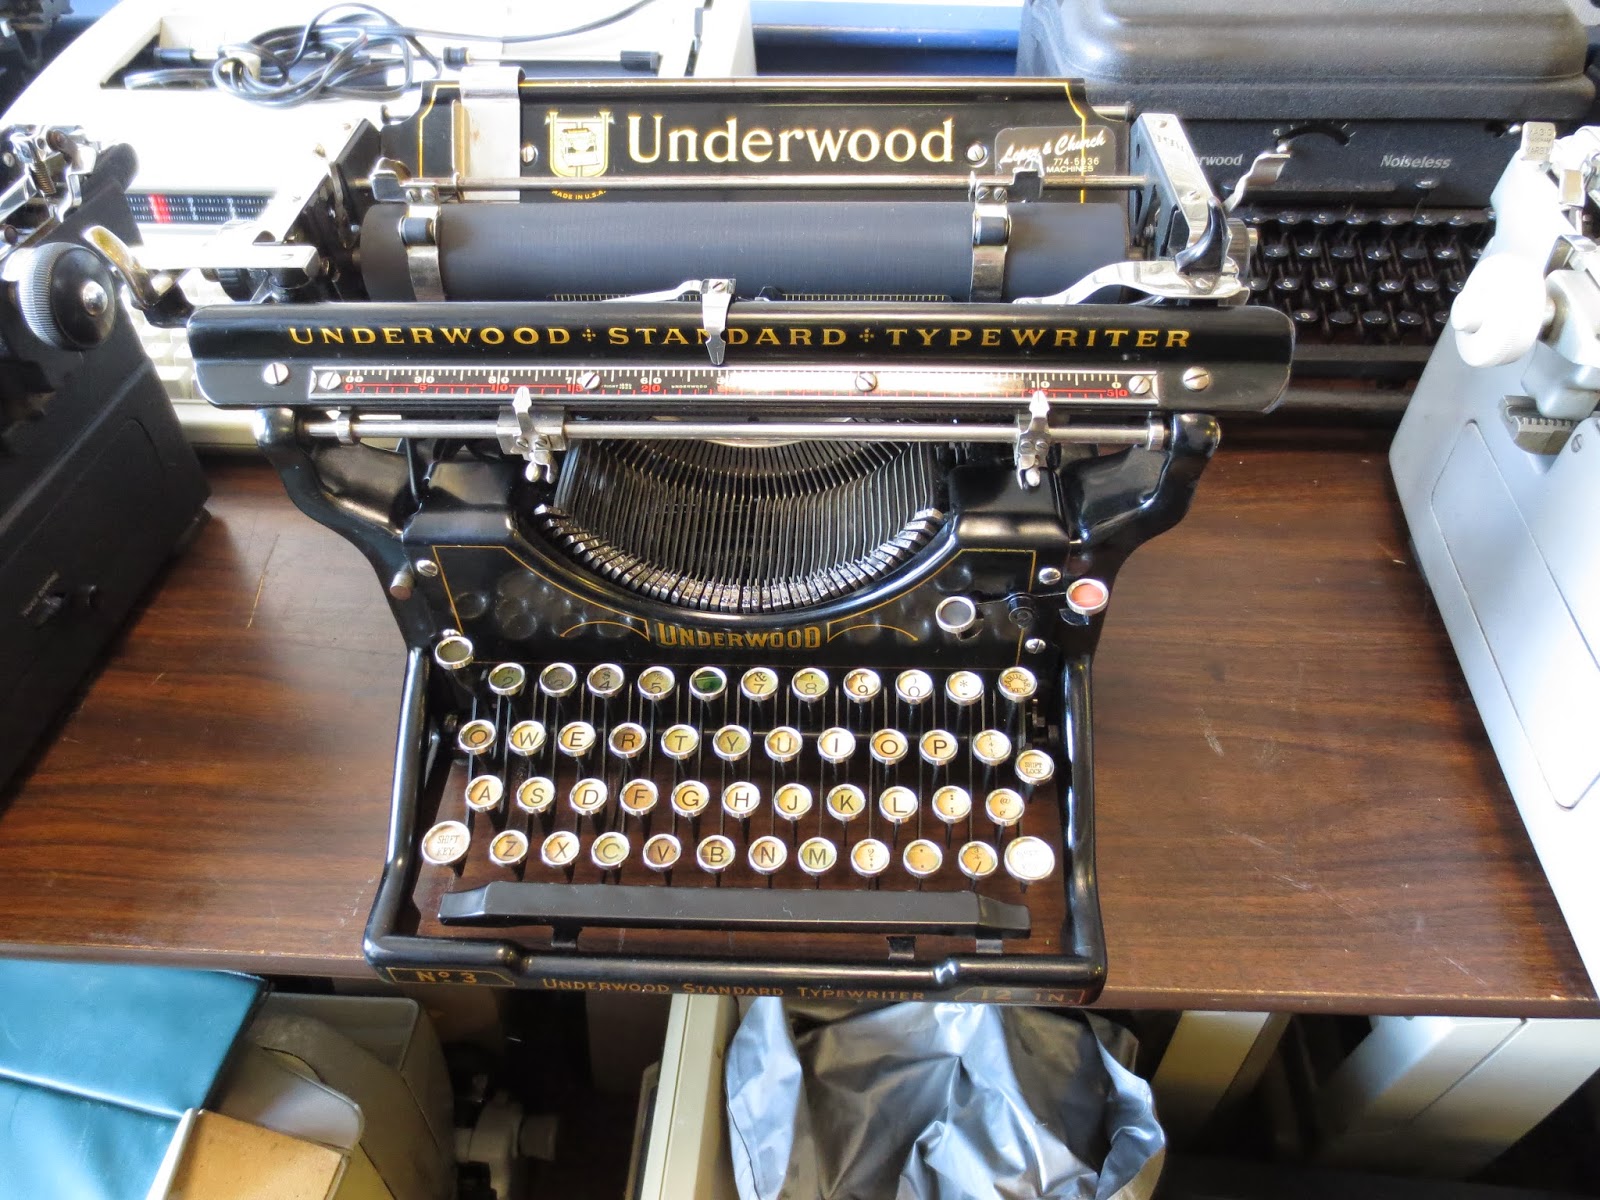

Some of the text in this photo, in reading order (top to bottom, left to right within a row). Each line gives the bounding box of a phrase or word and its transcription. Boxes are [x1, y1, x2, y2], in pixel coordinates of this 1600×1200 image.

[627, 113, 954, 163] Underwood
[1042, 141, 1052, 155] &
[1054, 130, 1106, 156] Church
[1380, 155, 1451, 169] Noiseless
[551, 190, 573, 200] MADE
[288, 327, 570, 345] UNDERWOOD
[885, 328, 1190, 348] TYPEWRITER
[414, 376, 435, 384] 90
[488, 376, 510, 384] 80
[641, 384, 660, 392] 20
[656, 622, 821, 649] UNDERWOOD
[502, 677, 514, 688] 2
[599, 680, 612, 691] 4
[651, 682, 662, 693] 5
[753, 683, 765, 693] 7
[805, 682, 817, 694] 8
[857, 684, 869, 695] 9
[519, 731, 539, 747] W
[569, 731, 585, 747] E
[621, 733, 635, 748] R
[675, 735, 688, 751] T
[727, 736, 739, 751] Y
[777, 737, 792, 753] U
[880, 739, 898, 755] O
[933, 739, 947, 755] P
[478, 785, 491, 801] A
[530, 787, 545, 804] S
[582, 789, 599, 805] D
[633, 789, 648, 805] F
[681, 790, 699, 807] G
[734, 792, 749, 807] H
[787, 795, 798, 811] J
[840, 794, 854, 811] K
[893, 796, 908, 813] L
[437, 835, 460, 844] SHIFT
[502, 841, 518, 857] Z
[555, 841, 570, 858] X
[602, 842, 621, 859] C
[657, 845, 671, 861] V
[710, 846, 724, 862] B
[760, 846, 775, 863] N
[808, 848, 826, 865] M
[461, 971, 477, 984] 3
[542, 978, 925, 1000] UNDERWOOD STANDARD TYPEWRITER
[981, 990, 1012, 1001] 12
